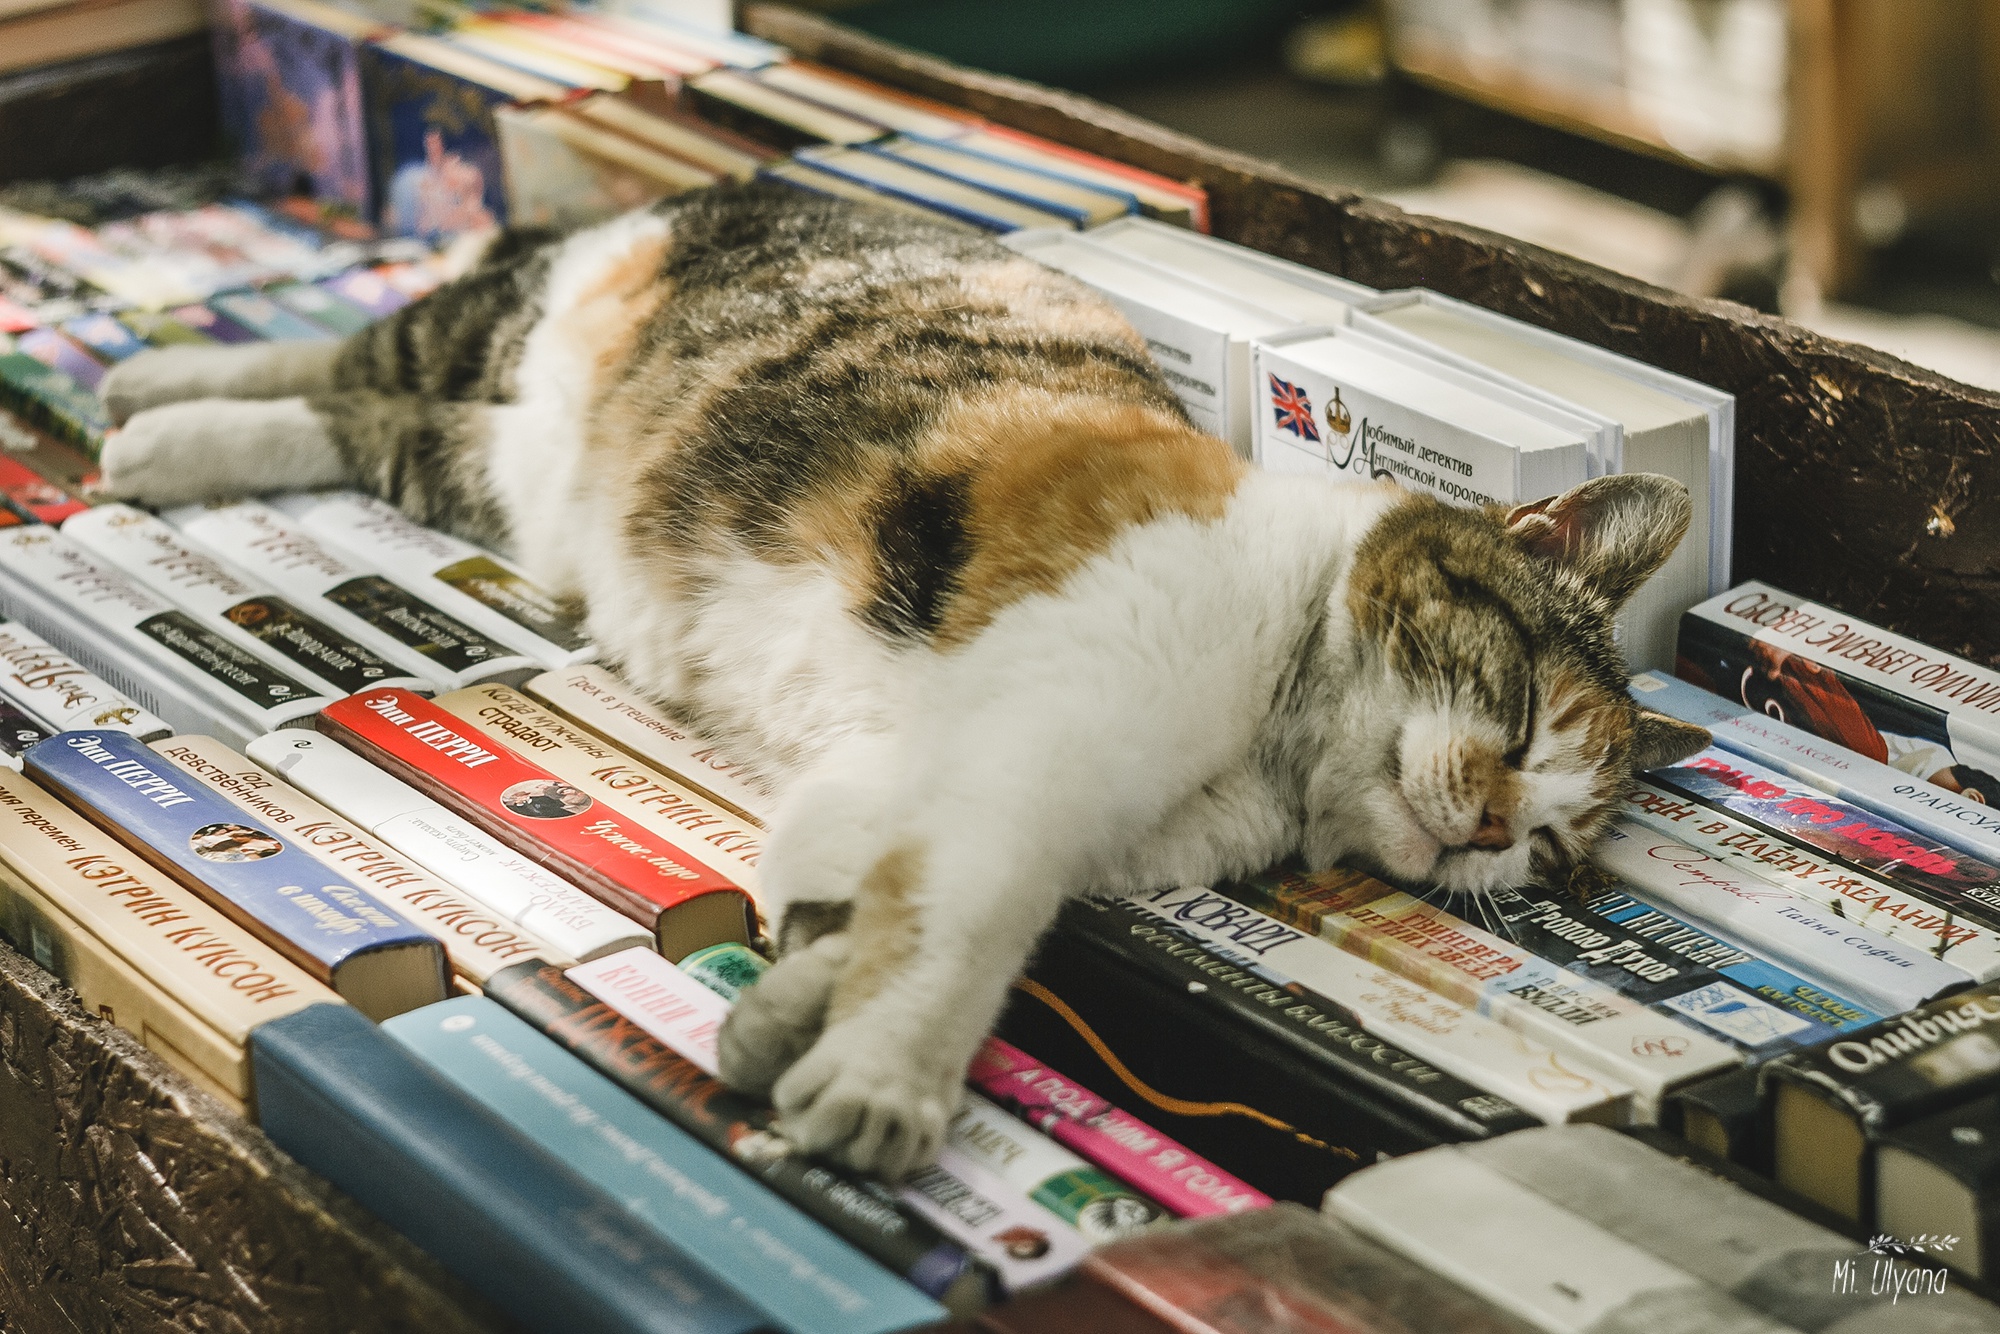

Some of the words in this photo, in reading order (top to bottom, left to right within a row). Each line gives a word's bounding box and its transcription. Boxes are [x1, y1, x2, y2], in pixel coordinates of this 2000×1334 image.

[1328, 417, 1416, 469] Любимый
[1417, 444, 1473, 478] детектив
[1353, 441, 1436, 488] Английской
[1439, 478, 1502, 508] королев
[1723, 592, 1824, 638] СЬЮЗЕН
[1805, 622, 1928, 676] ЭЛИЗАБЕТ
[566, 674, 606, 699] Грех
[601, 694, 612, 705] в
[361, 693, 417, 727] Энн
[403, 718, 501, 770] ПЕРРИ
[478, 706, 564, 754] страдают
[481, 686, 538, 719] Когда
[532, 714, 615, 762] мужчины
[606, 700, 687, 743] утешение
[66, 733, 104, 765] Энн
[102, 758, 197, 810] ПЕРРИ
[164, 746, 297, 824] девственников
[235, 770, 274, 790] Год
[590, 764, 723, 833] КЭТРИН
[13, 806, 87, 852] перемен
[1775, 796, 1846, 826] ПРО
[1892, 784, 2000, 836] ФРАНСУА
[293, 820, 425, 890] КЭТРИН
[402, 888, 542, 960] КУКСОН
[646, 852, 701, 882] лицо
[66, 854, 191, 927] КЭТРИН
[163, 926, 298, 1005] КУКСОН
[1344, 908, 1430, 950] ЛЕТНИХ
[1428, 949, 1501, 982] ЗВЕЗД
[1399, 912, 1524, 974] ГВИНЕВЕРА
[1503, 900, 1612, 950] ТРОПОЮ
[1576, 939, 1679, 984] ДУХОВ
[1776, 905, 1842, 938] Тайна
[1843, 936, 1914, 970] Софии
[1534, 977, 1622, 1020] ПЕРСИЯ
[1033, 1077, 1094, 1119] ПОД
[1148, 1148, 1187, 1170] Я
